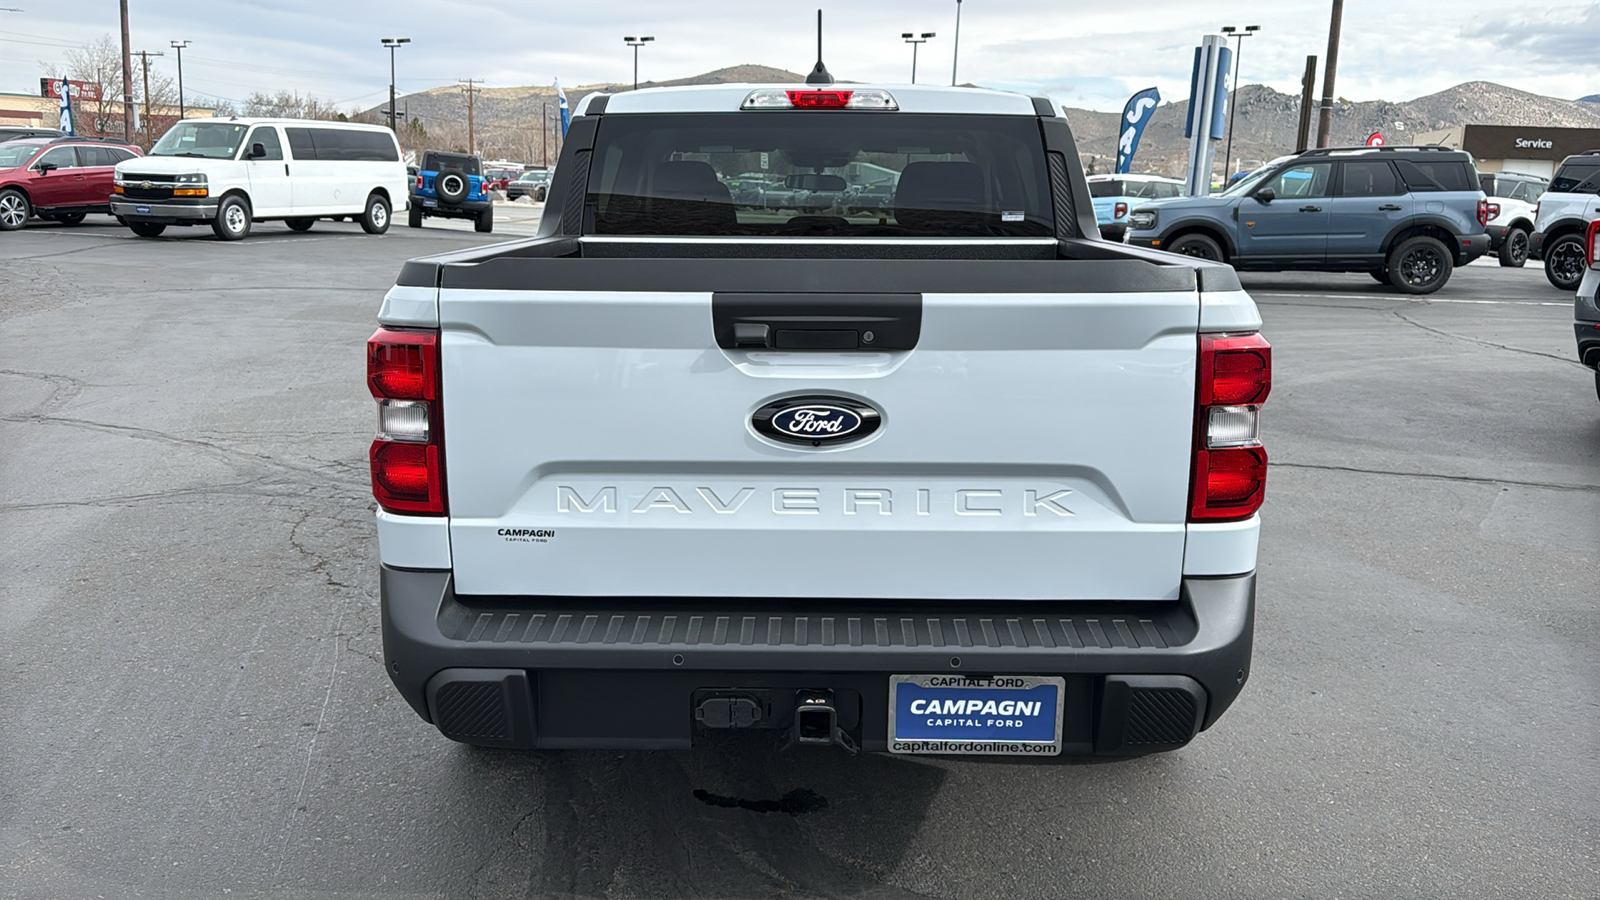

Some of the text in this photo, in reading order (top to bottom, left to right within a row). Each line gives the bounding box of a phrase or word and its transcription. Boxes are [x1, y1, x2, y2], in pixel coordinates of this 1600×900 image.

[1515, 137, 1553, 149] Service
[789, 409, 845, 432] Ford
[556, 486, 1076, 516] MAVERICK
[497, 528, 556, 538] CAMPAGNI
[930, 677, 1025, 688] CAPITAL FORD
[910, 699, 1042, 717] CAMPAGNI
[926, 718, 1024, 728] CAPITAL FORD
[892, 741, 1057, 754] capitalfordonline.com
